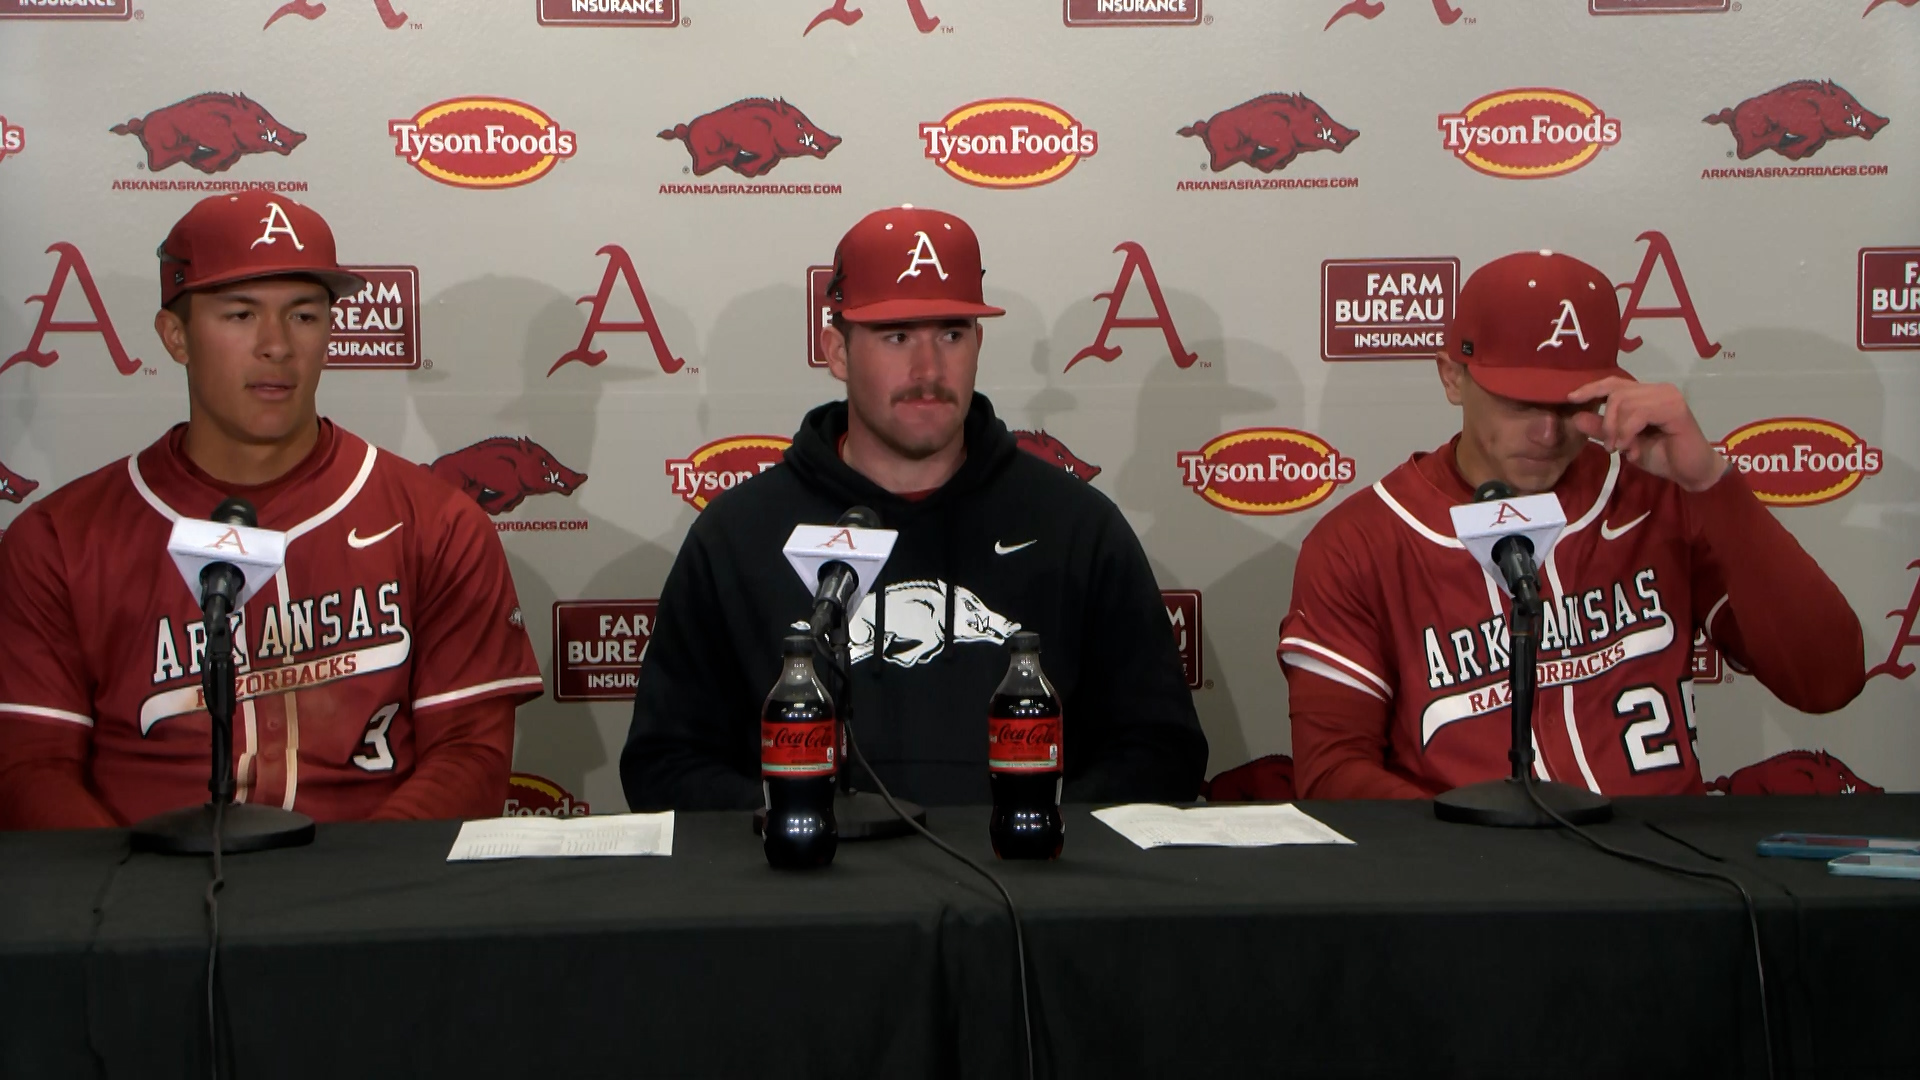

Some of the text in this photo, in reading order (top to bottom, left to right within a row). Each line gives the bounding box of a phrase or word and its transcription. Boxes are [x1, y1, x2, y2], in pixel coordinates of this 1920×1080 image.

[393, 124, 573, 161] Tyson Foods
[923, 125, 1094, 163] Tyson Foods
[1442, 115, 1617, 154] Tyson Foods
[336, 281, 402, 304] RM
[1367, 273, 1443, 296] FARM
[1335, 298, 1444, 323] BUREAU
[1872, 288, 1920, 311] BUR
[330, 306, 404, 331] REAU
[327, 341, 406, 356] SURANCE
[1354, 331, 1445, 348] INSURANCE
[1792, 444, 1879, 472] Foods
[1182, 453, 1352, 490] Tyson Foods
[599, 614, 657, 637] FAR
[567, 639, 650, 664] BURE
[587, 673, 641, 689] INSUR
[352, 702, 400, 771] 3
